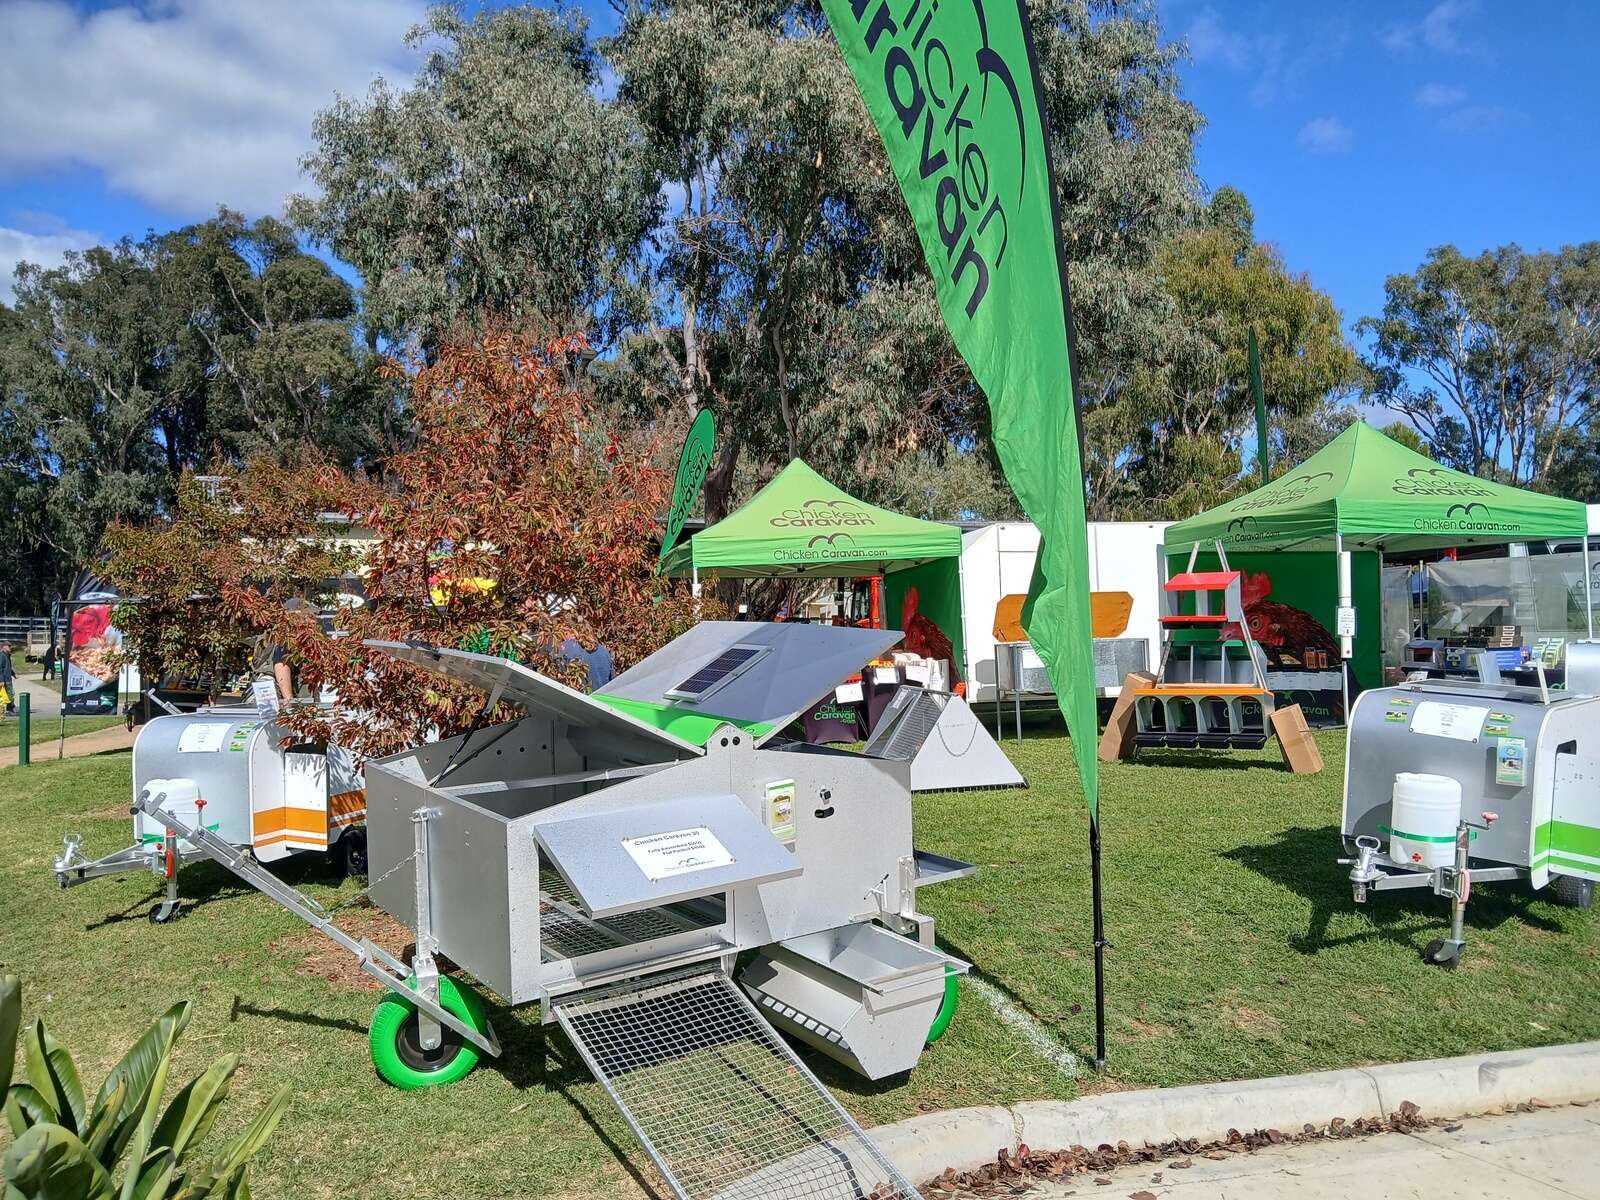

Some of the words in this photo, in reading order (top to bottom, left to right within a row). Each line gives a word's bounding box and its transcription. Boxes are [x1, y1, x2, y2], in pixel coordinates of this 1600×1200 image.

[1394, 478, 1486, 489] Chicken
[670, 453, 707, 535] Caravan
[1392, 486, 1498, 497] Caravan
[782, 509, 871, 519] Chicken
[769, 517, 876, 528] Caravan
[1413, 518, 1457, 530] Chicken
[1458, 520, 1521, 531] Caravan.com
[773, 549, 819, 560] Chicken
[821, 549, 888, 558] Caravan.com
[814, 711, 856, 721] Caravan
[634, 837, 663, 846] Chicken
[663, 833, 692, 841] Caravan
